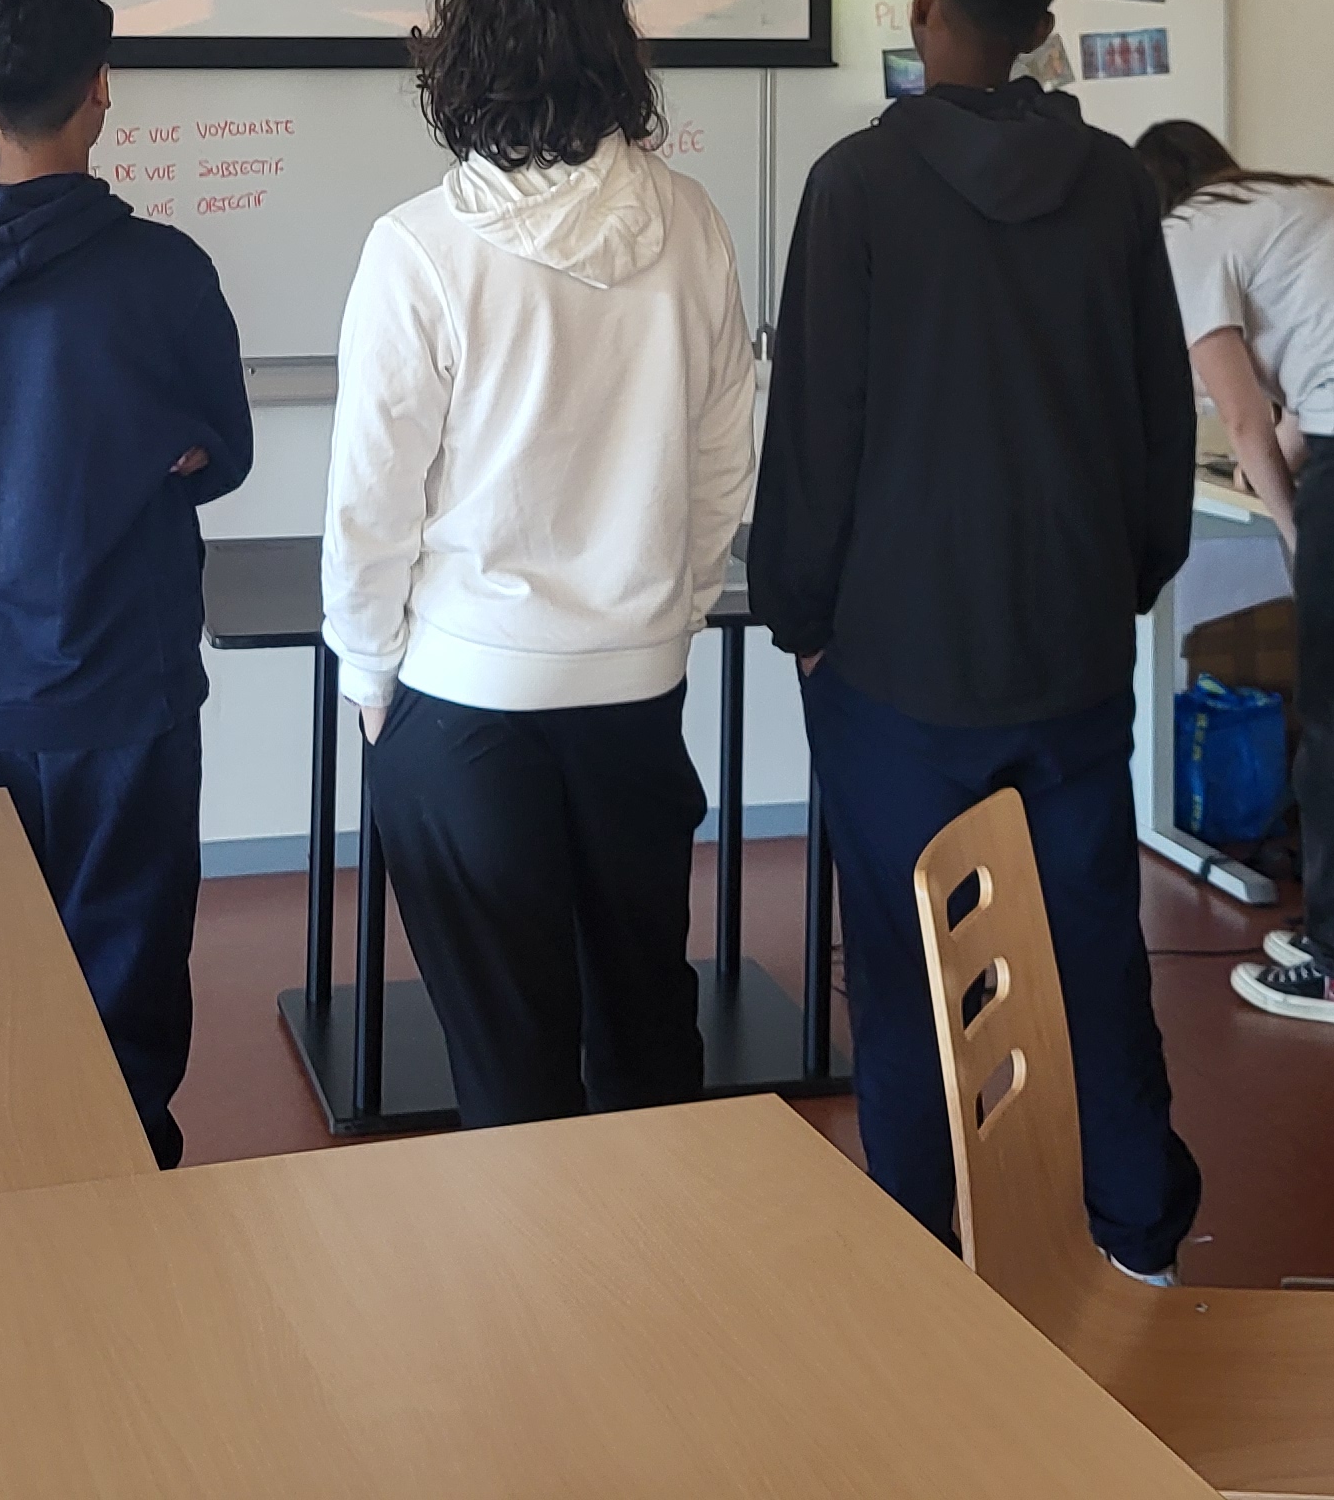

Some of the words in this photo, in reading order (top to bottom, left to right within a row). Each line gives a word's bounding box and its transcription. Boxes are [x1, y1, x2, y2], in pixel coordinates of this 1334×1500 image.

[117, 127, 140, 146] DE
[149, 125, 182, 143] VUE
[196, 119, 296, 139] VOYEURISTE
[115, 163, 137, 182] DE
[145, 163, 176, 181] VUE
